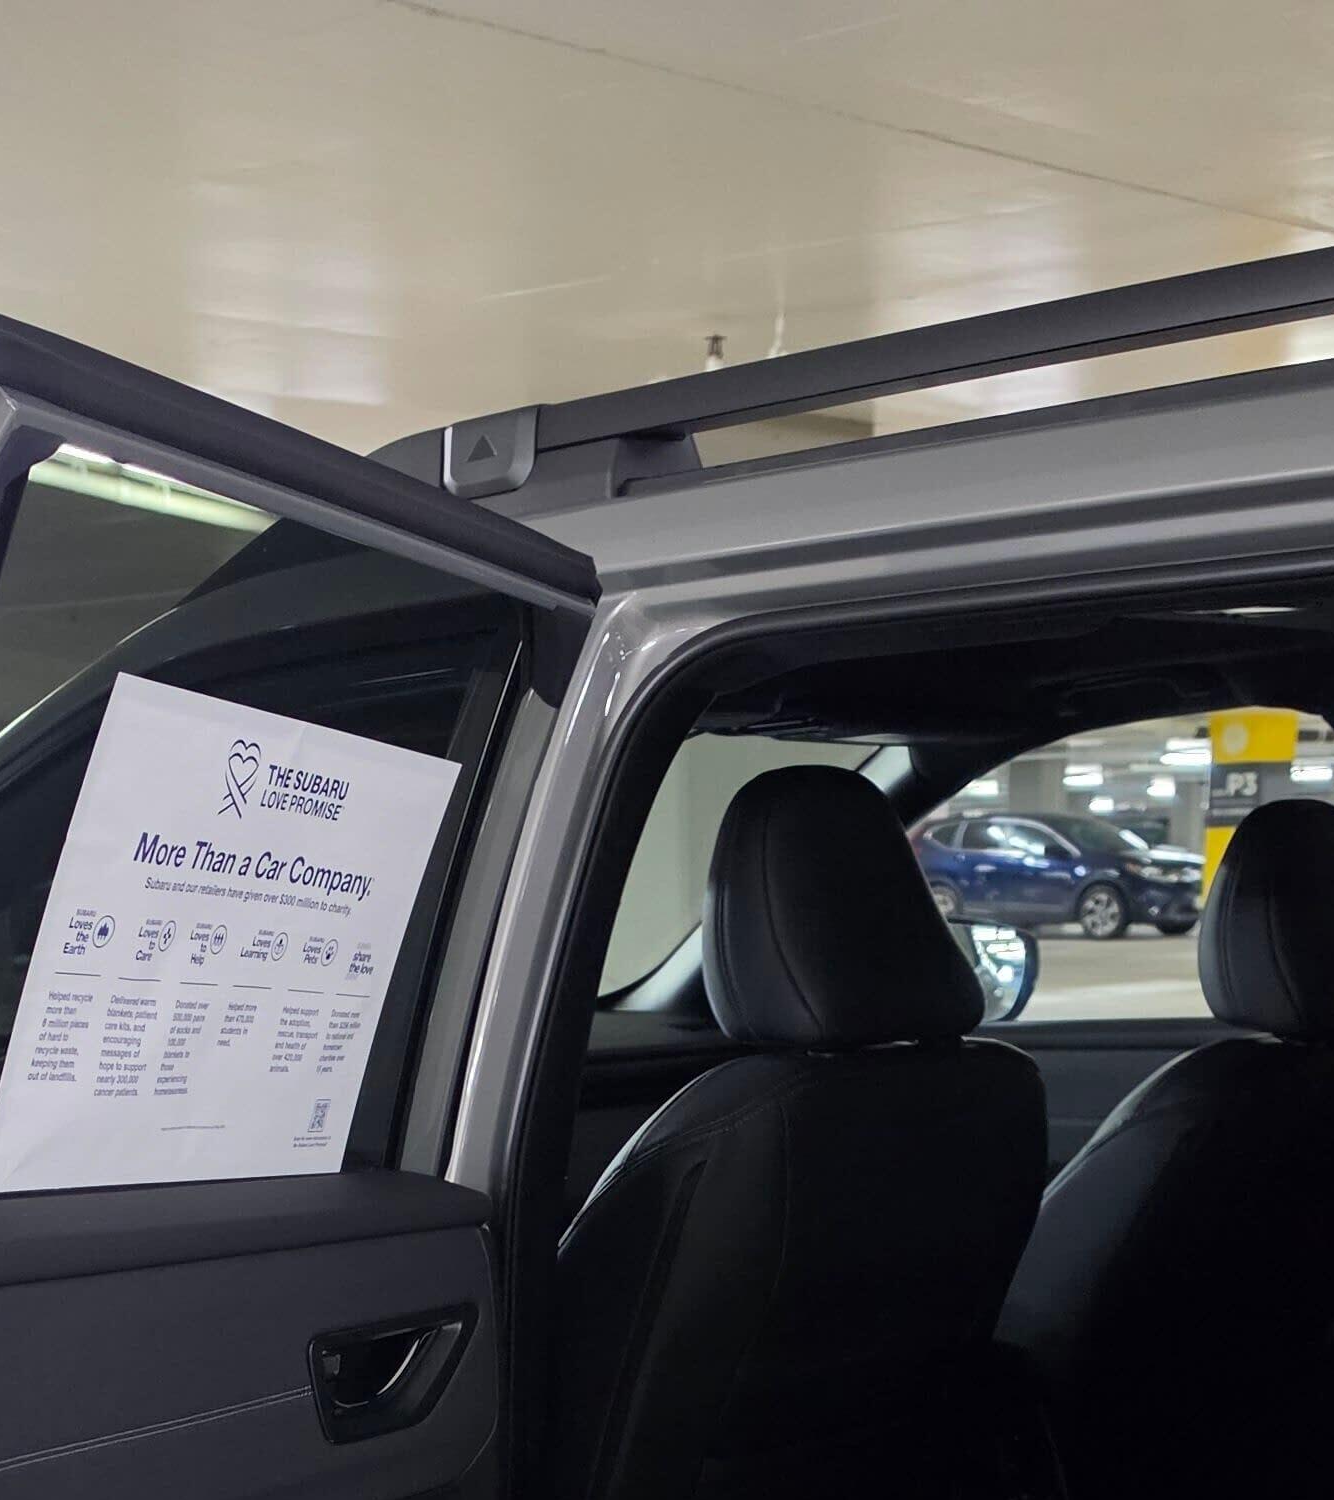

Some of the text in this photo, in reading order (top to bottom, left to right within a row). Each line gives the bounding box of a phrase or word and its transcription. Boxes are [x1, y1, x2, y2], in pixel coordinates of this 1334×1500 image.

[268, 765, 349, 800] THE SUBARU
[1226, 772, 1258, 796] P3
[260, 789, 342, 821] LOVE PROMISE
[134, 832, 186, 867] More
[192, 841, 236, 874] Than
[238, 856, 251, 876] a
[255, 852, 286, 881] Car
[145, 877, 171, 891] Subaru
[172, 880, 185, 892] and
[186, 883, 198, 893] our
[200, 884, 226, 897] retailers
[227, 886, 243, 899] have
[243, 890, 263, 902] given
[264, 893, 279, 903] over
[279, 894, 296, 906] $300
[296, 896, 319, 909] million
[320, 901, 327, 911] to
[69, 917, 93, 930] Loves
[76, 931, 89, 942] the
[138, 927, 159, 938] Loves
[190, 930, 209, 941] Loves
[149, 941, 155, 950] to
[201, 943, 207, 952] to
[253, 937, 271, 948] Loves
[303, 943, 321, 953] Loves
[63, 942, 85, 955] Earth
[240, 947, 268, 961] Learning
[136, 950, 152, 961] Care
[190, 953, 204, 966] Help
[304, 955, 318, 964] Pets
[353, 952, 371, 962] share
[349, 963, 373, 975] the love
[49, 991, 93, 1004] Helped recycle
[39, 1032, 68, 1041] of hard to
[35, 1046, 58, 1056] recycle
[101, 1049, 140, 1059] messages of
[31, 1058, 74, 1070] keeping them
[99, 1061, 146, 1071] hope to support
[27, 1072, 39, 1080] out
[40, 1072, 48, 1080] of
